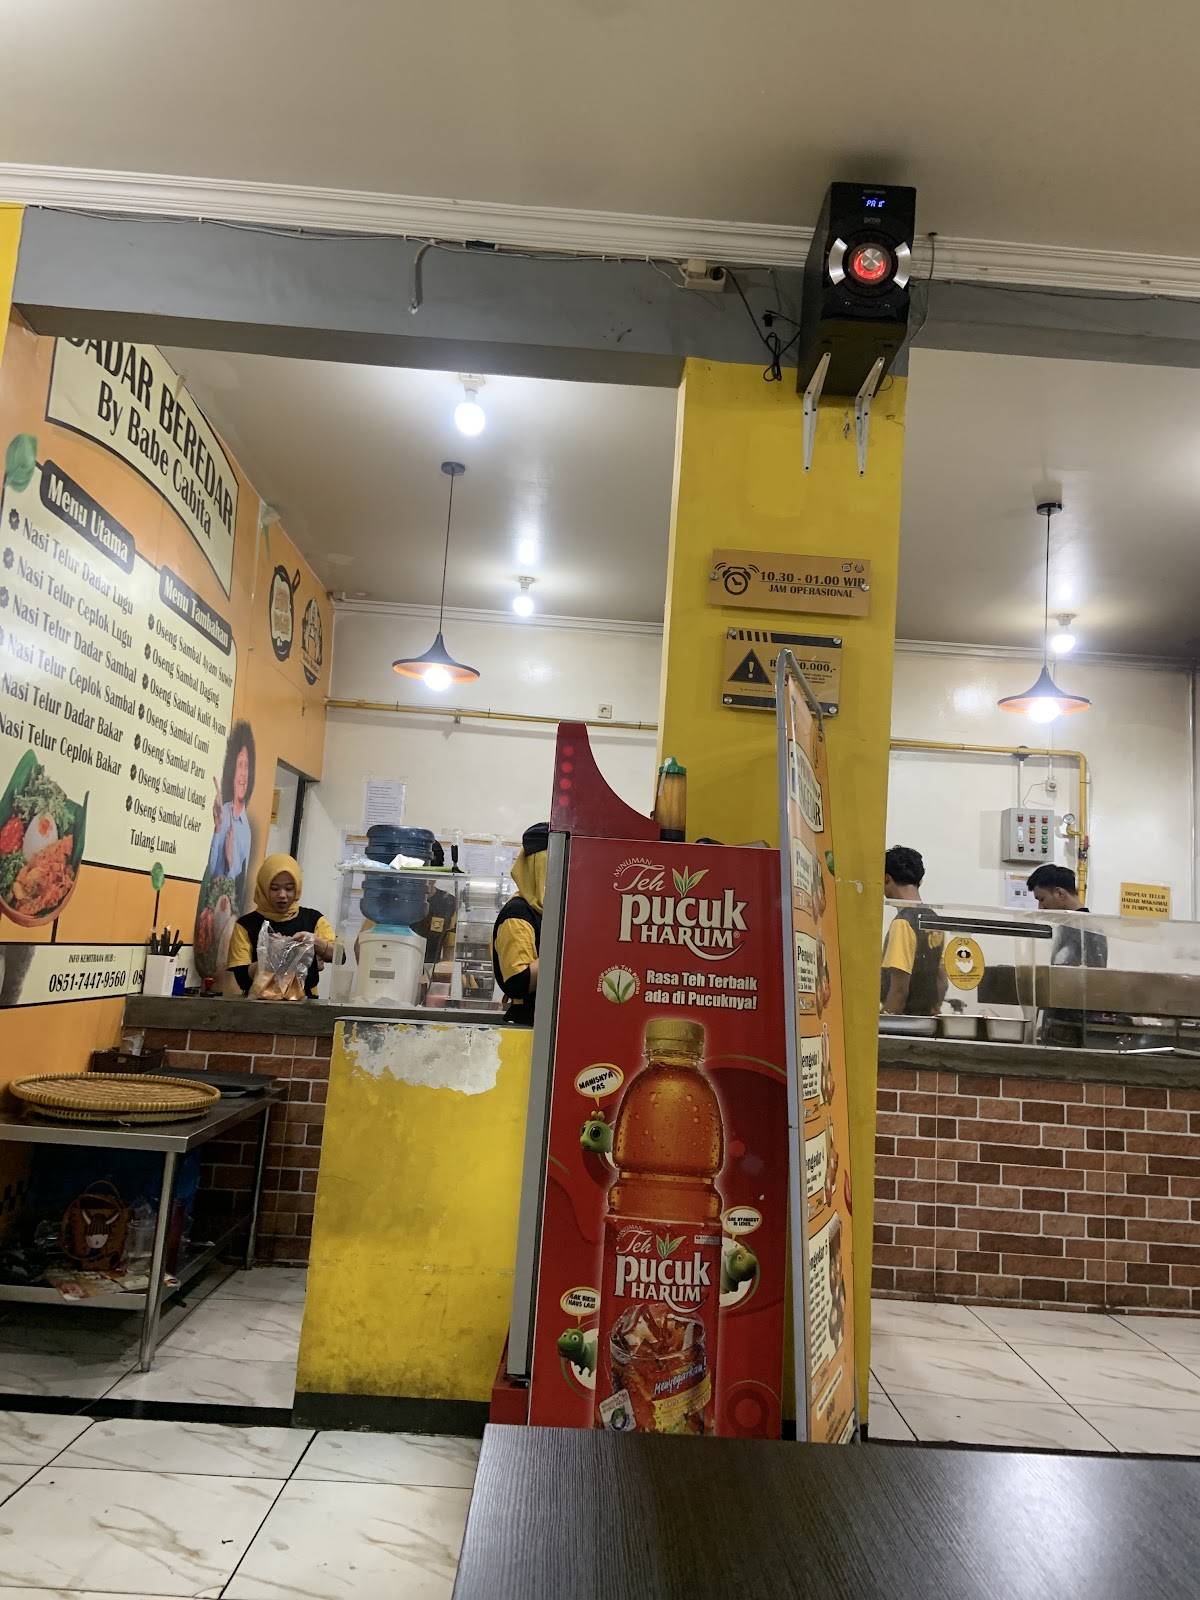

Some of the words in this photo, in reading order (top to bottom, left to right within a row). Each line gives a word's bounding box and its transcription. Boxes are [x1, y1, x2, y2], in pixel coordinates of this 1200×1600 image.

[64, 337, 153, 412] ADAR
[159, 383, 233, 536] BEREDAR
[98, 380, 123, 435] By
[127, 406, 169, 476] Babe
[172, 459, 212, 539] Cabita
[48, 473, 88, 527] Menu
[91, 510, 128, 563] Utama
[23, 518, 50, 552] Nasi
[52, 538, 80, 574] Telur
[82, 562, 111, 597] Dadar
[112, 585, 134, 615] Lugu
[760, 571, 794, 583] 10.30
[805, 574, 840, 585] 01.00
[17, 556, 44, 589] Nasi
[48, 575, 75, 609] Telur
[78, 598, 108, 633] Ceplok
[111, 619, 132, 648] Lugu
[164, 575, 189, 613] Menu
[769, 584, 787, 593] JAM
[790, 587, 855, 598] OPERASIONAL
[13, 594, 39, 627] Nasi
[43, 612, 71, 644] Telur
[73, 631, 103, 664] Dadar
[105, 651, 137, 683] Sambal
[156, 619, 178, 650] Oseng
[179, 636, 201, 665] Sambal
[8, 633, 34, 664] Nasi
[38, 648, 66, 680] Telur
[69, 667, 101, 699] Ceplok
[104, 685, 136, 716] Sambal
[153, 649, 175, 679] Oseng
[176, 664, 199, 691] Sambal
[200, 681, 220, 708] Daging
[1, 672, 29, 702] Nasi
[33, 685, 61, 716] Telur
[64, 701, 95, 730] Dadar
[97, 716, 124, 742] Bakar
[150, 678, 172, 707] Oseng
[173, 692, 196, 719] Sambal
[213, 716, 227, 736] Ayam
[28, 723, 57, 751] Telur
[60, 737, 93, 765] Ceplok
[96, 751, 122, 775] Bakar
[146, 708, 168, 736] Oseng
[169, 720, 193, 746] Sambal
[194, 734, 210, 754] Cumi
[142, 737, 165, 765] Oseng
[166, 748, 190, 773] Sambal
[191, 761, 206, 779] Paru
[138, 767, 161, 794] Oseng
[162, 778, 186, 802] Sambal
[187, 787, 206, 810] Udang
[134, 798, 157, 823] Oseng
[158, 807, 183, 828] Sambal
[183, 815, 202, 832] Ceker
[130, 829, 155, 853] Tulang
[157, 836, 177, 854] Lunak
[613, 857, 652, 877] MINUMAN
[613, 863, 666, 892] Teh
[618, 888, 748, 942] pucuk
[640, 925, 738, 955] HARUM
[49, 971, 126, 993] 0851-7447-9560
[644, 989, 670, 1003] ada
[672, 991, 686, 1005] di
[688, 992, 757, 1011] Pucuknya!
[646, 970, 679, 985] Rasa
[682, 973, 706, 987] Teh
[707, 974, 758, 991] Terbaik
[579, 1072, 614, 1089] MANISNYA
[591, 1083, 606, 1093] PAS
[615, 1229, 653, 1254] Teh
[614, 1251, 712, 1297] pucuk
[631, 1283, 702, 1307] HARUM
